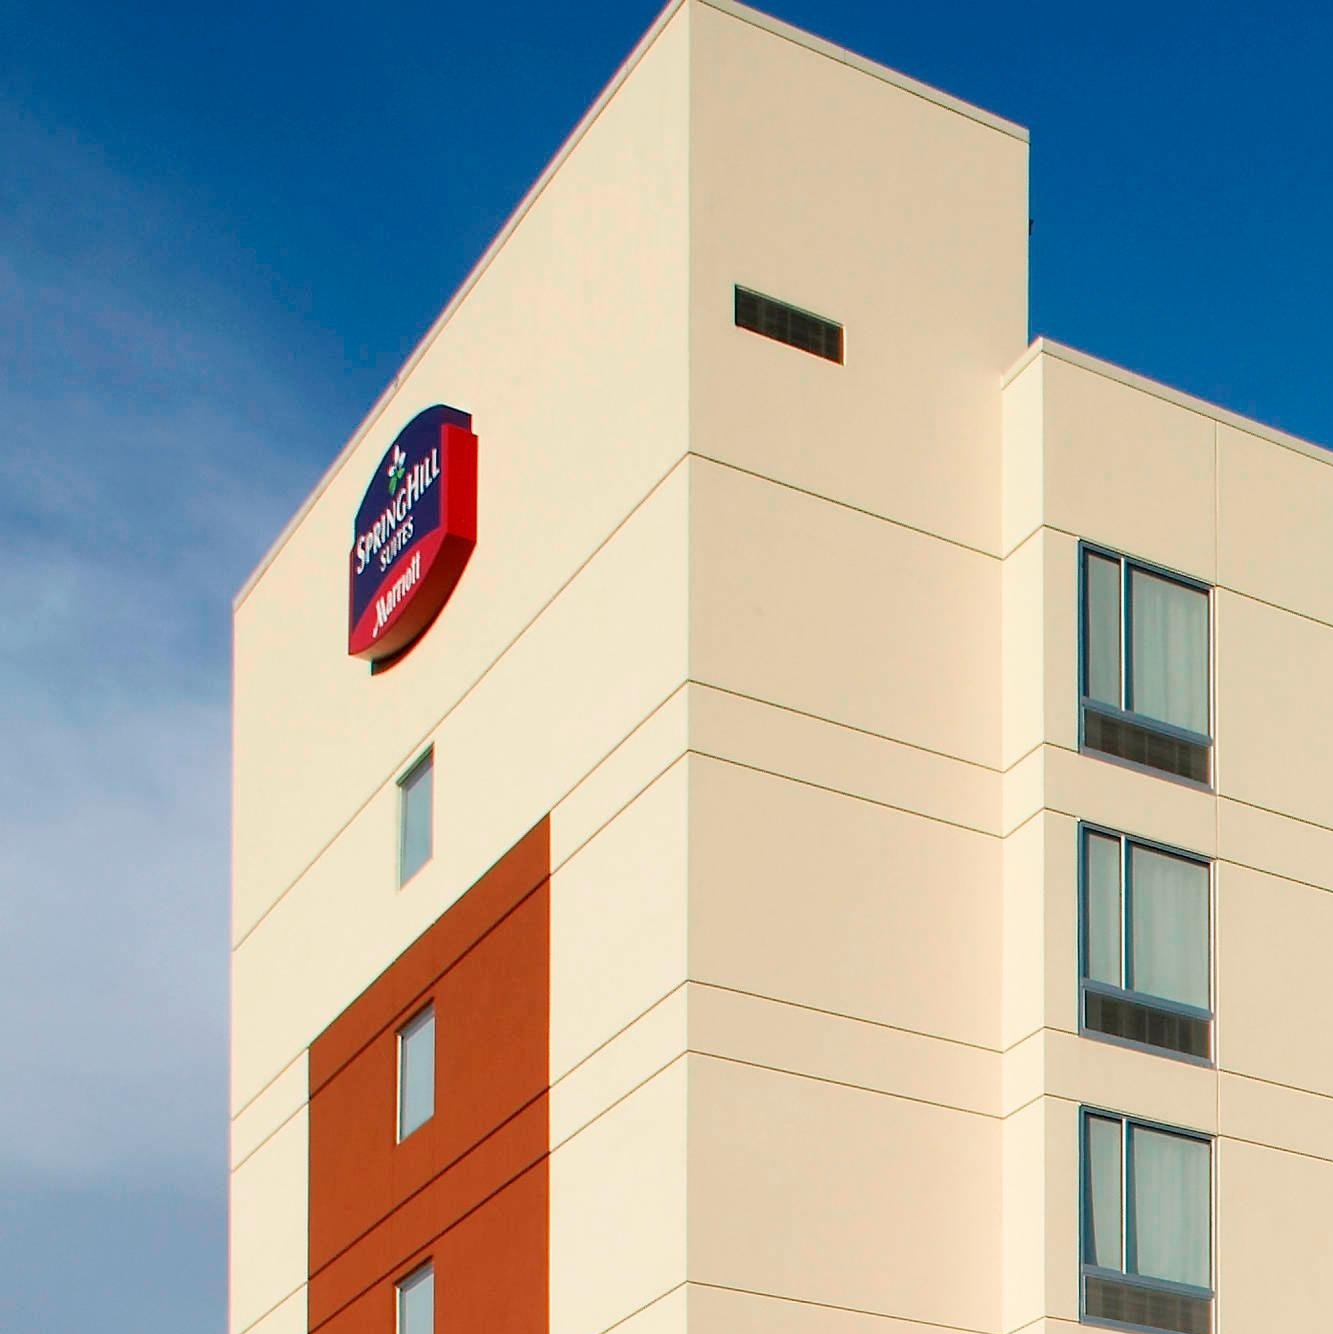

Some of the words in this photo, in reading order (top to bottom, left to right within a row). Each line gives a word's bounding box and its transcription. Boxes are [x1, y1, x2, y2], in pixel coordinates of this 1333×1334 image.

[355, 448, 441, 575] SPRINGHILL
[380, 516, 414, 573] SUITES
[372, 550, 421, 639] Marriott
